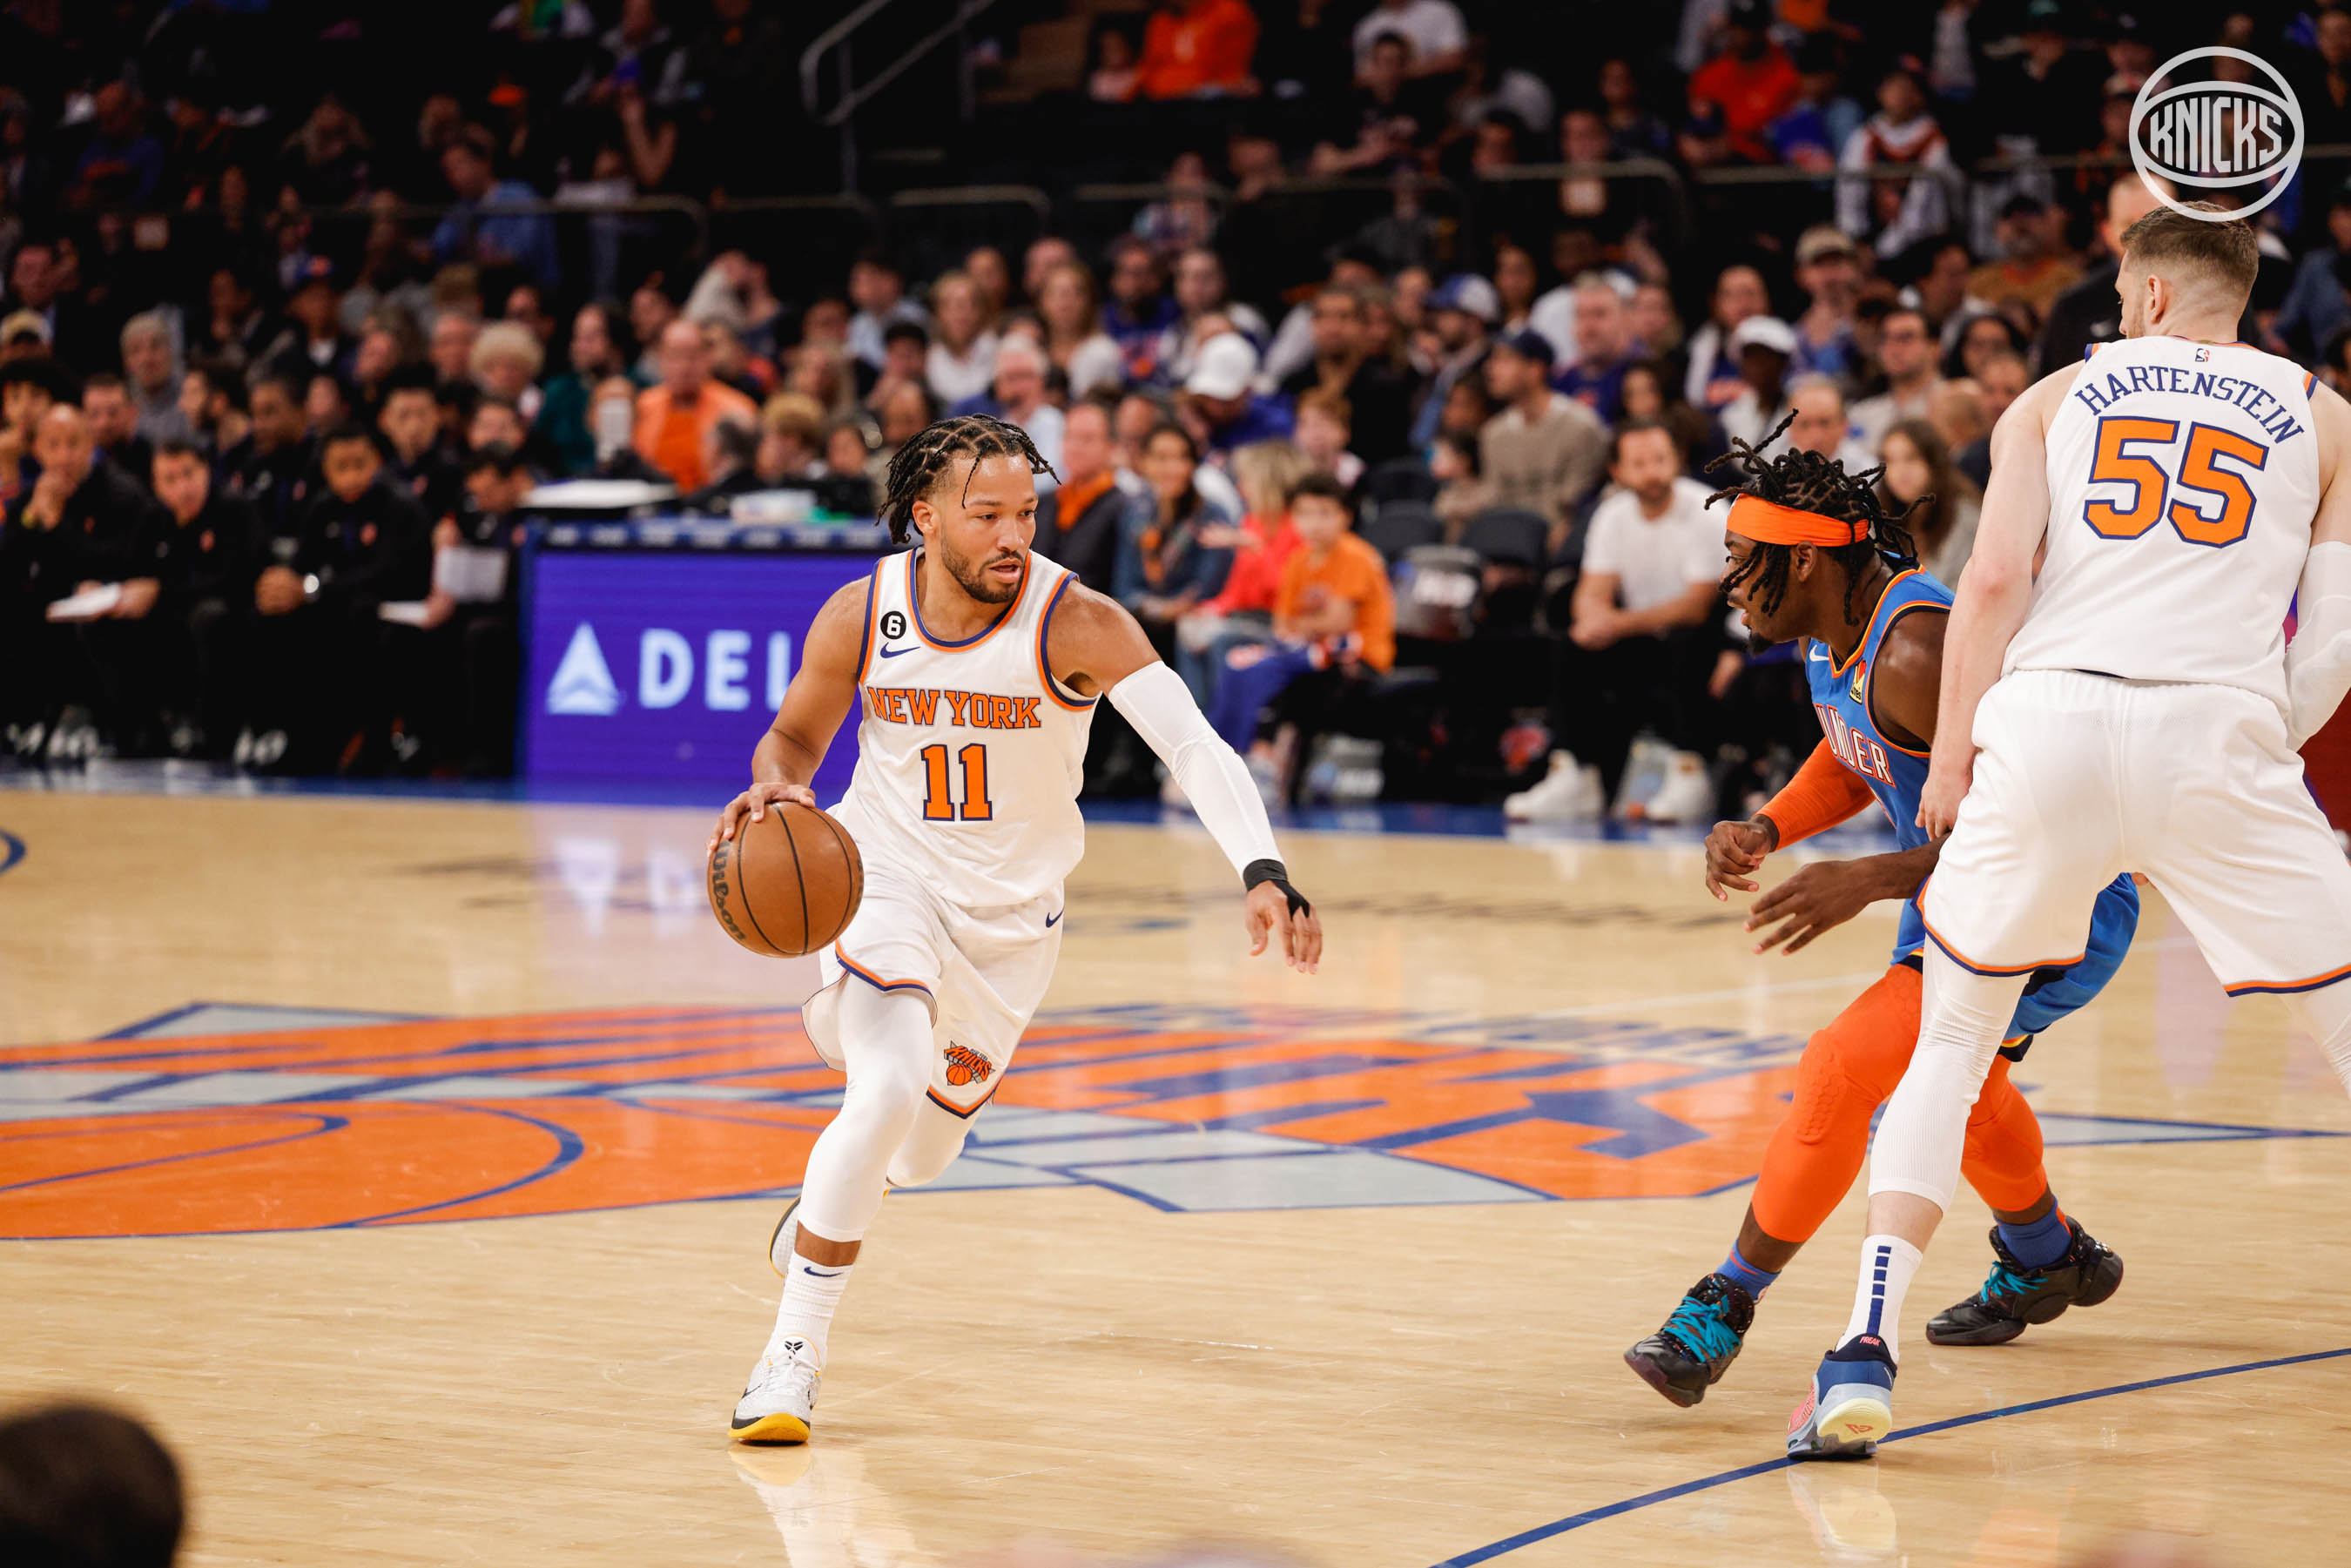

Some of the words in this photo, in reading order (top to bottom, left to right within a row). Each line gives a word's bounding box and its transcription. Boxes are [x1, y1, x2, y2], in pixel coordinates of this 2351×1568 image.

[2075, 366, 2304, 444] HARTENSTEIN
[2083, 416, 2269, 548] 55
[886, 615, 901, 636] 6
[639, 627, 792, 713] DEL
[866, 686, 940, 725] NEW
[945, 690, 1042, 730] YORK
[920, 743, 993, 822] 11
[1813, 703, 1896, 789] UNDER
[944, 1045, 993, 1081] KNICKS
[1859, 1336, 1881, 1347] FREAK
